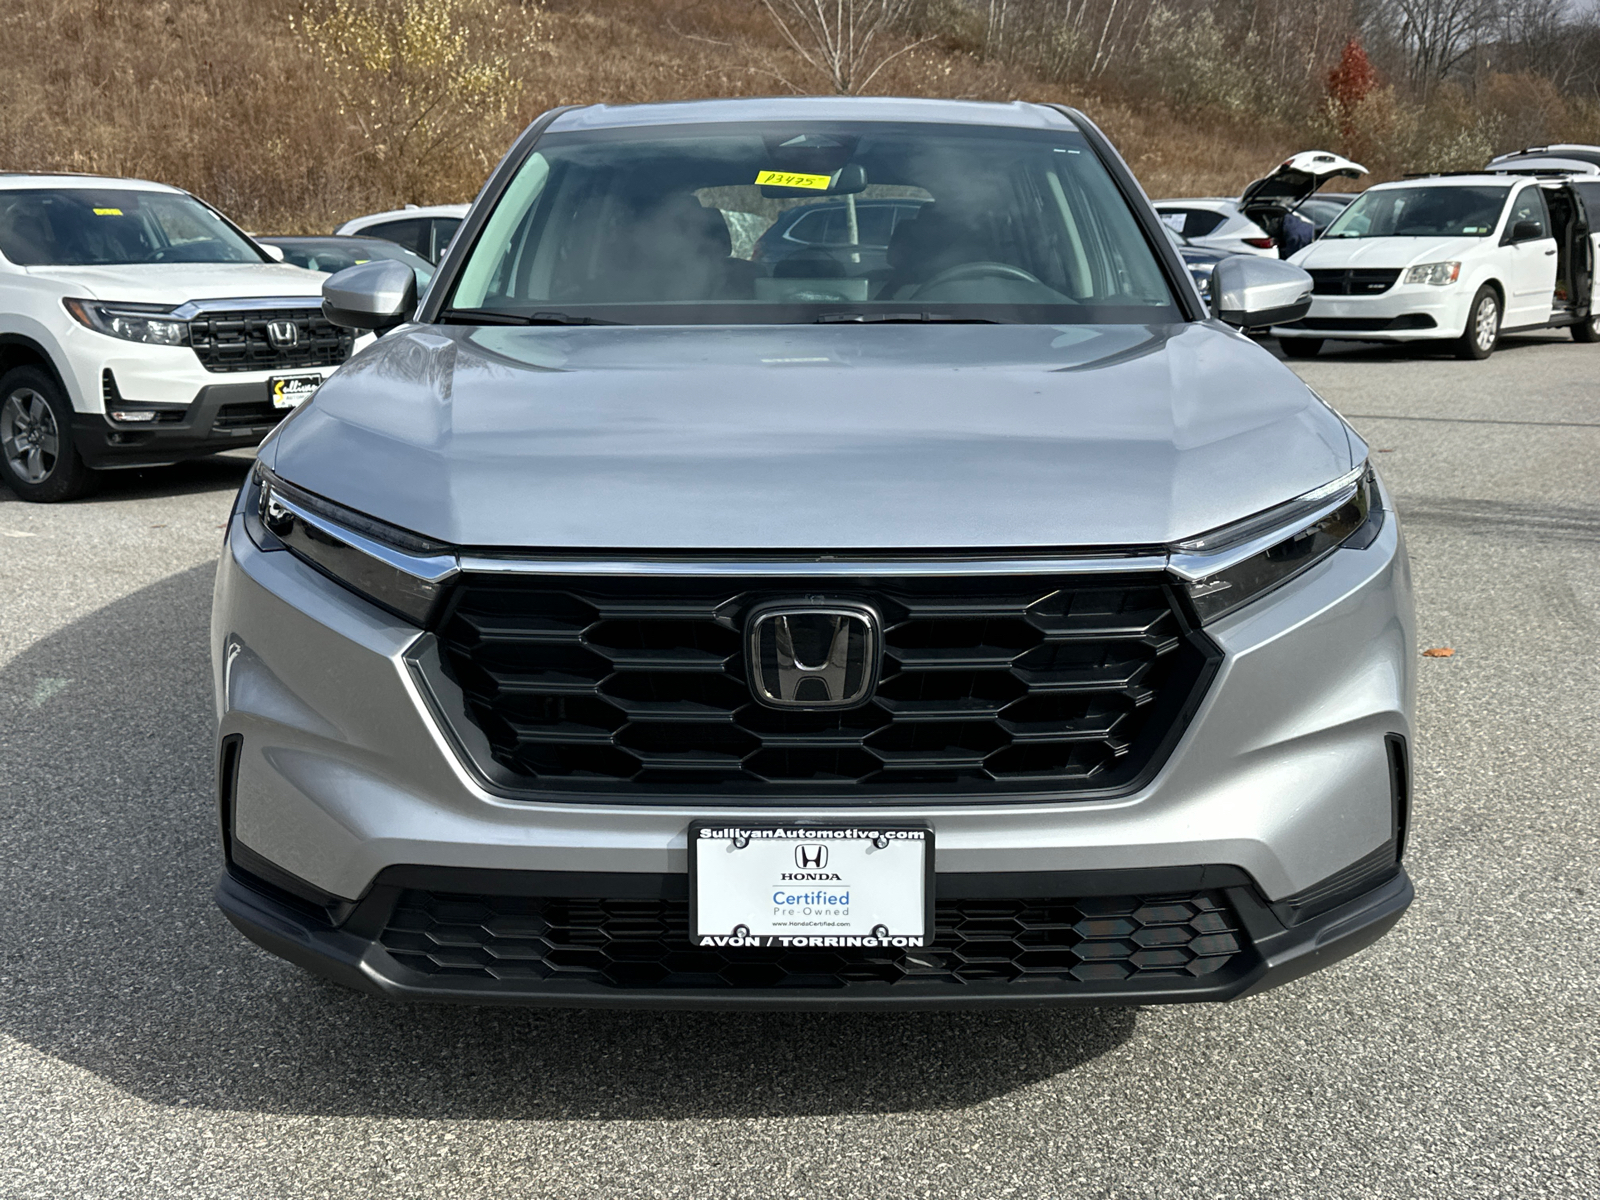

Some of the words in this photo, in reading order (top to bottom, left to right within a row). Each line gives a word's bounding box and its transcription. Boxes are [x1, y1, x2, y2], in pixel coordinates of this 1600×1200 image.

[700, 828, 925, 839] SullivanAutomotive.com
[780, 873, 842, 881] HONDA
[772, 890, 850, 905] Certified
[773, 906, 850, 916] Pre-Owned
[700, 936, 760, 947] AVON
[778, 936, 924, 947] TORRINGTON
